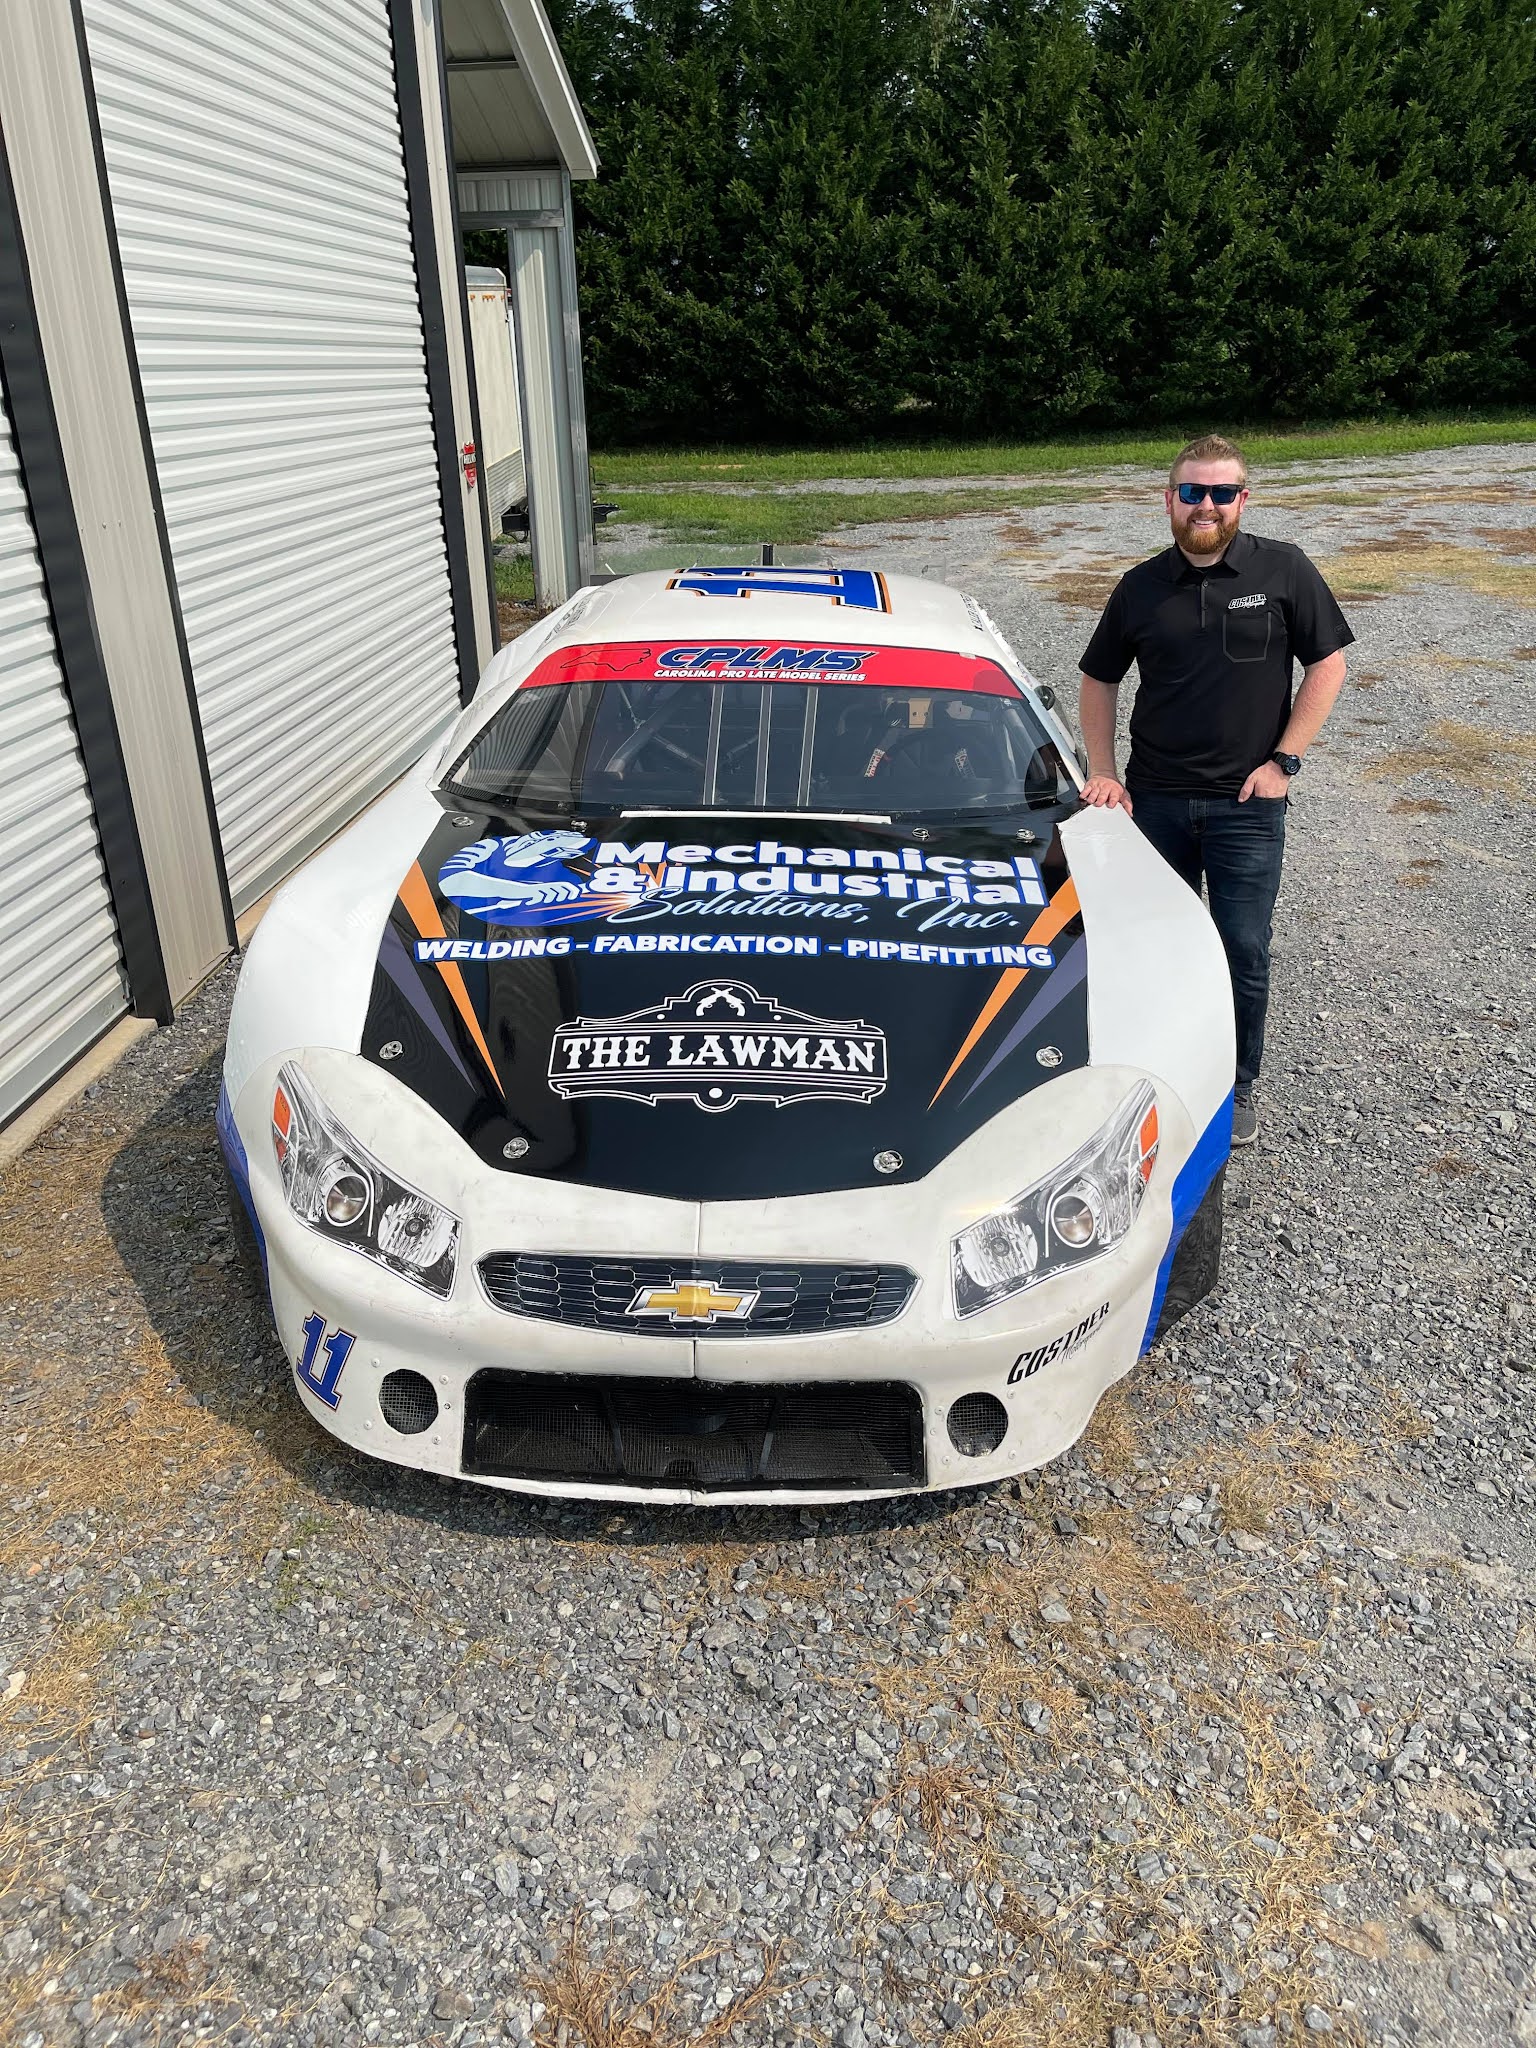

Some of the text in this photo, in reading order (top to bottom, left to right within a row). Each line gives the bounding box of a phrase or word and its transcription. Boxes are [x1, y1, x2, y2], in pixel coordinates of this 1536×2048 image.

[665, 567, 892, 614] 11
[653, 669, 866, 682] CAROLINA PRO LATE MODEL SERIES
[656, 646, 880, 672] CPLMS
[595, 841, 1039, 879] Mechanical
[589, 866, 1046, 906] & Industrial
[606, 886, 1020, 933] Solutions, Inc.
[417, 937, 570, 960] WELDING
[594, 935, 818, 955] FABRICATION
[847, 939, 1052, 966] PIPEFITTING
[562, 1035, 876, 1073] THE LAWMAN
[296, 1310, 358, 1413] 11
[1006, 1301, 1110, 1385] COSTNER
